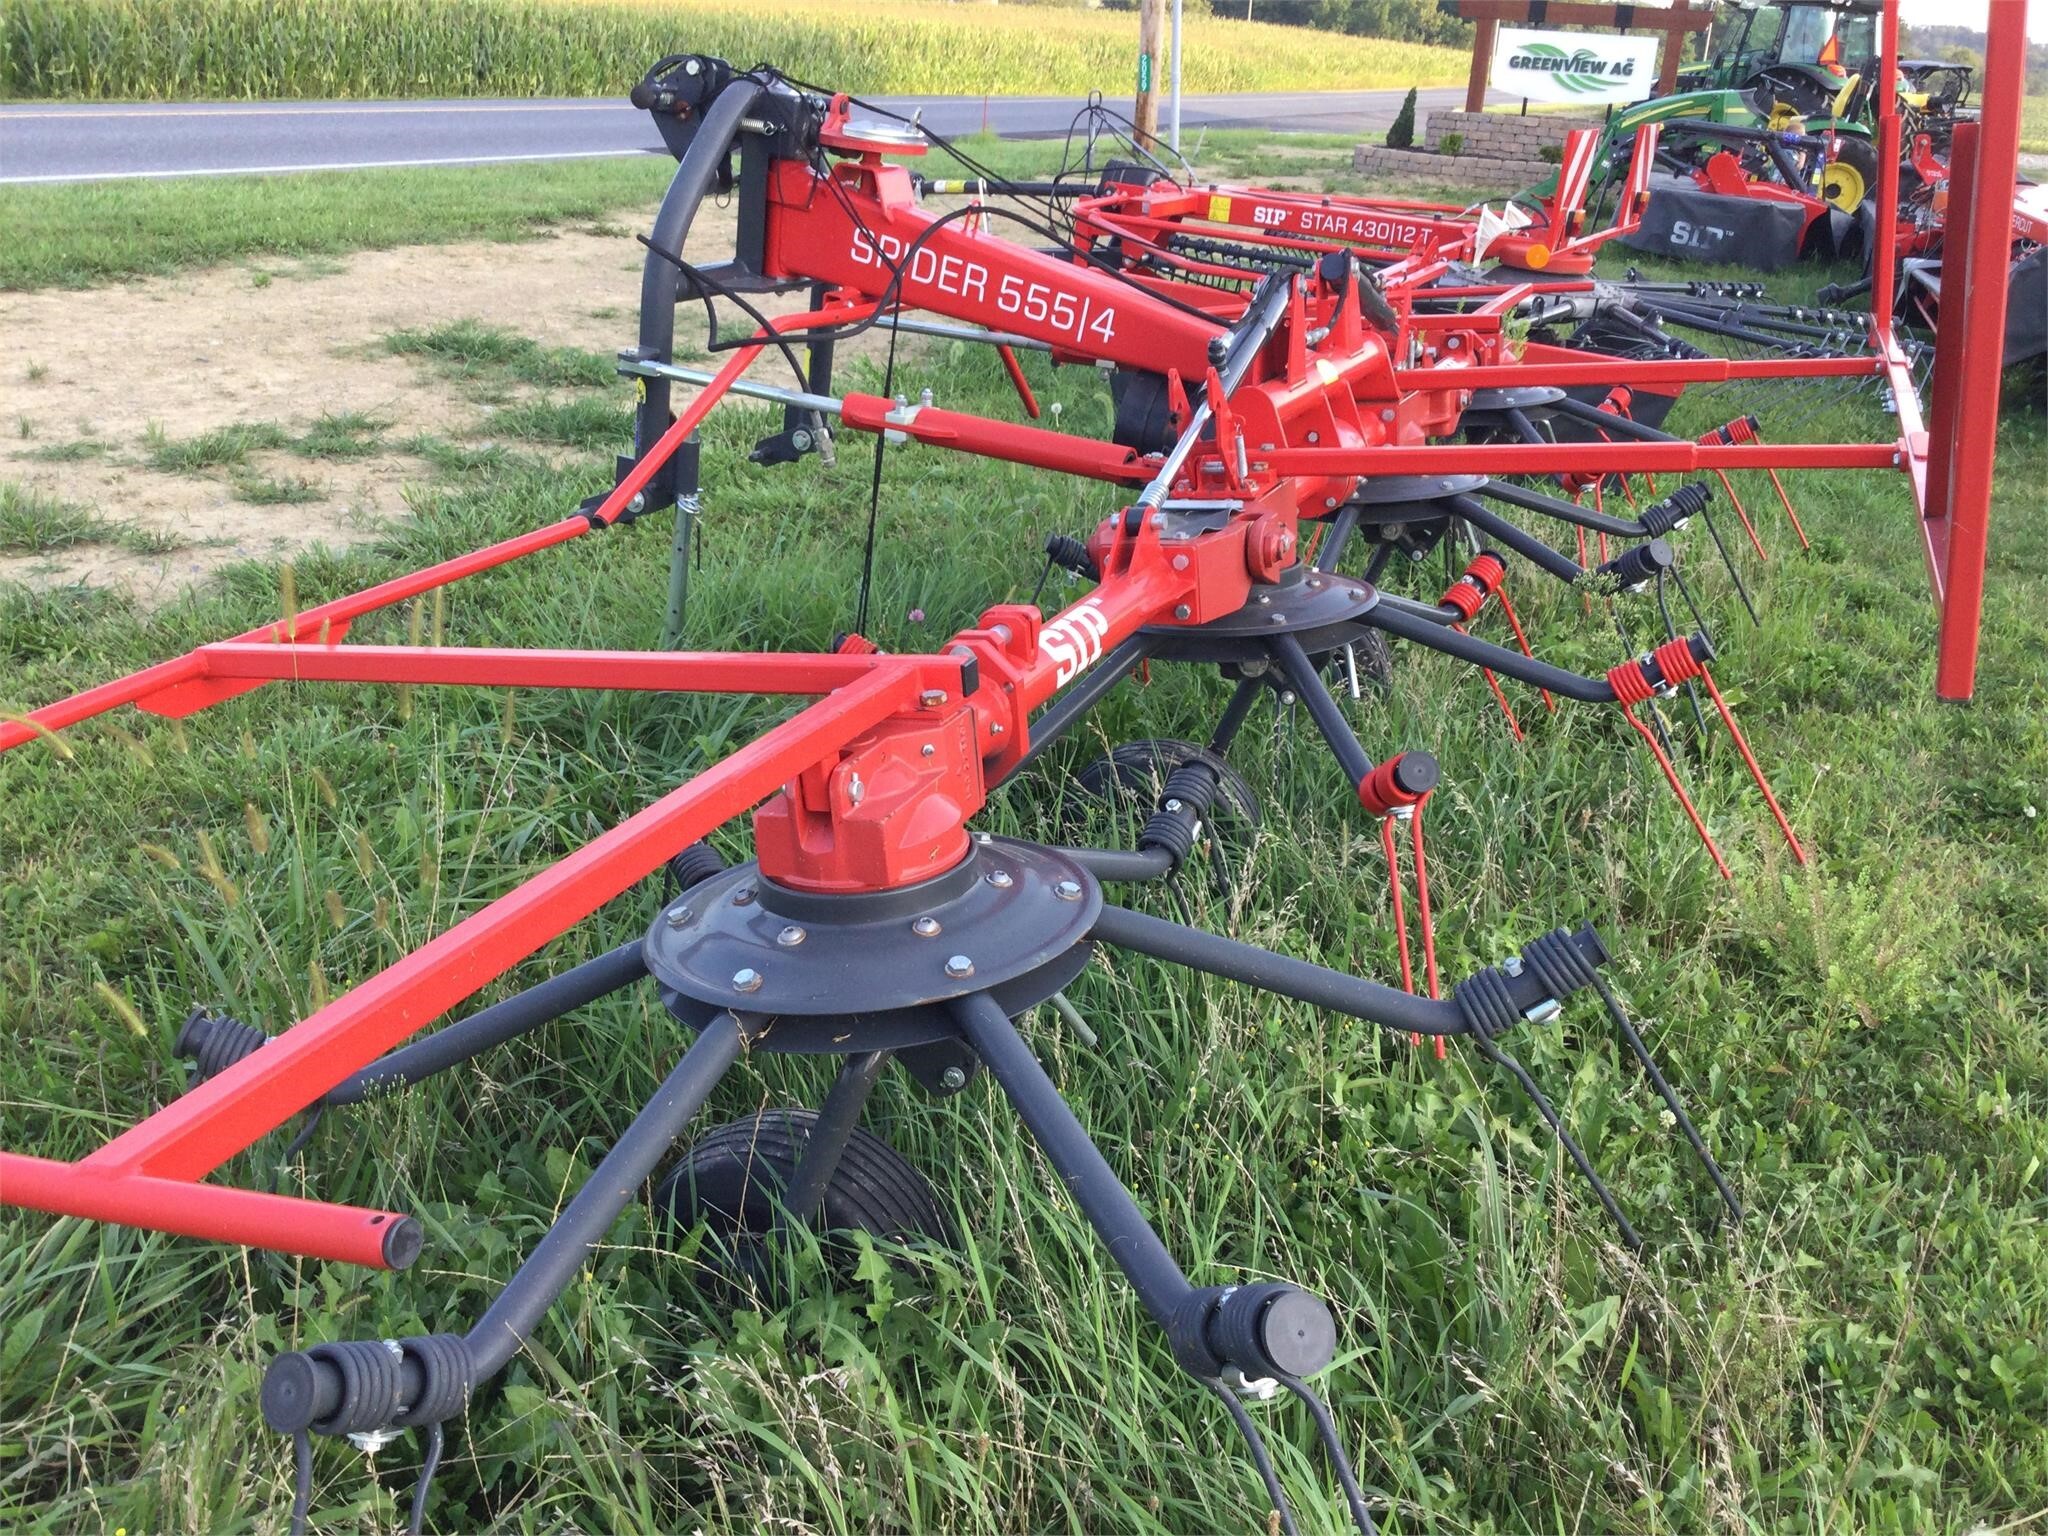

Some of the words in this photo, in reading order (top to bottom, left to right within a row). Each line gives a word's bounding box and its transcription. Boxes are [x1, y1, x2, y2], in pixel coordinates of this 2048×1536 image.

[1509, 54, 1608, 75] GREENVIEW
[1609, 62, 1634, 76] AG
[1253, 206, 1287, 226] SIP
[1300, 212, 1348, 234] STAR
[850, 226, 989, 302] SPIDER
